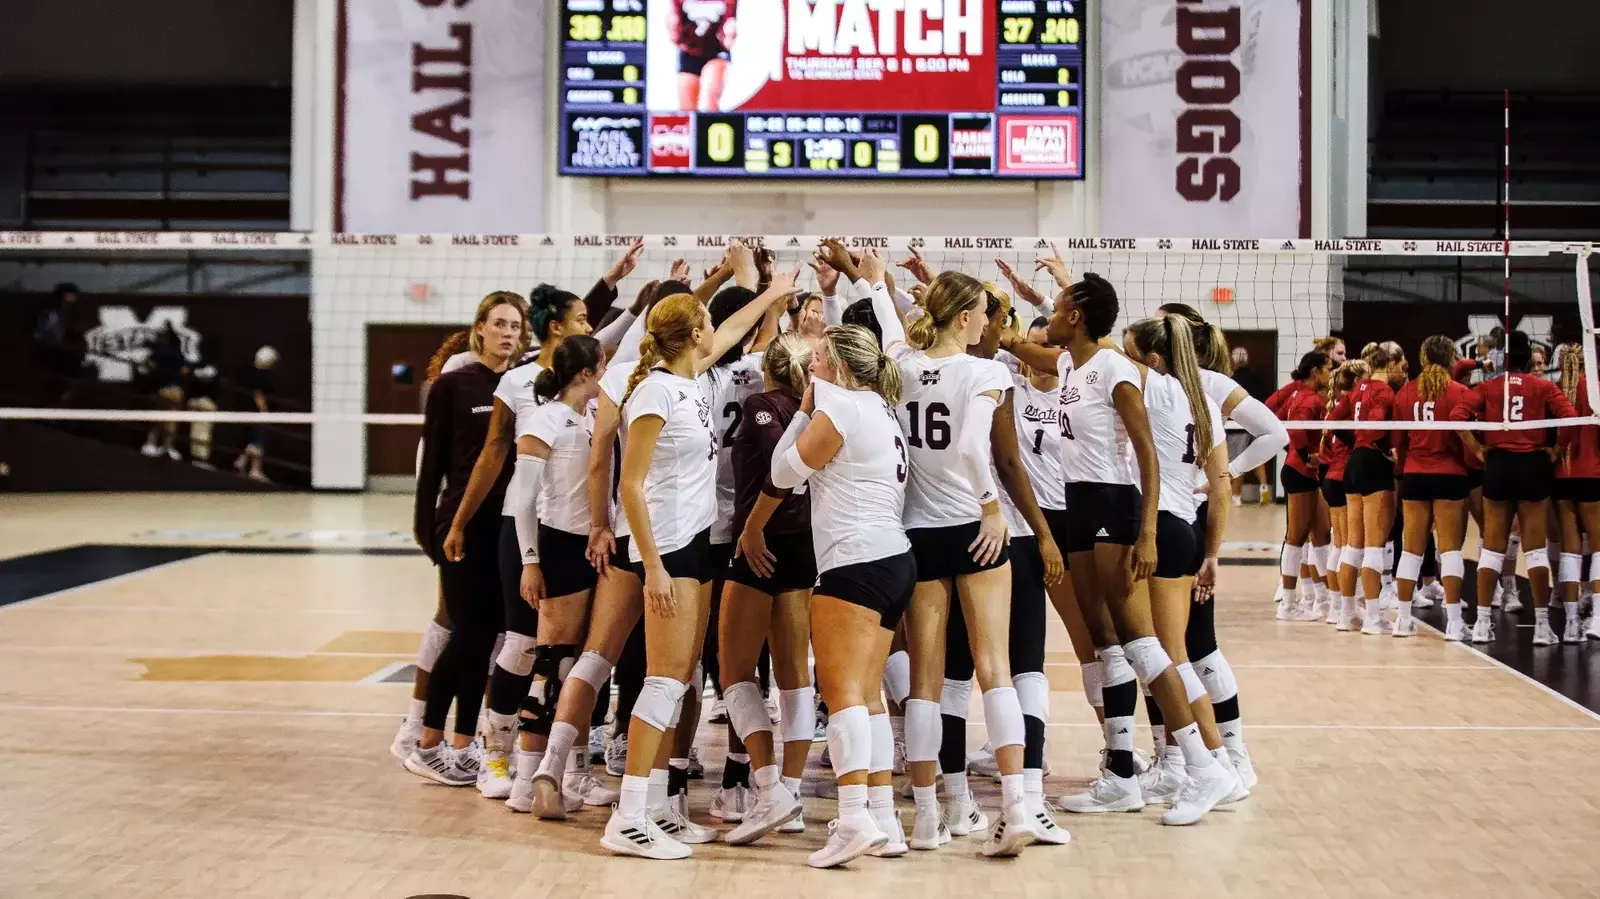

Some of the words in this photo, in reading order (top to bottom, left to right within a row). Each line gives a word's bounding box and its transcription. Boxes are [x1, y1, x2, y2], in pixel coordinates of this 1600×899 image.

[788, 0, 983, 55] MATCH
[1003, 17, 1034, 43] 37
[1041, 18, 1079, 43] .240
[410, 22, 472, 201] HAIL
[1176, 0, 1241, 202] DOGS
[708, 123, 734, 163] 0
[773, 141, 792, 167] 3
[854, 141, 872, 167] 0
[914, 124, 939, 163] 0
[331, 234, 359, 245] HAIL
[362, 234, 397, 246] STATE
[451, 235, 480, 246] HAIL
[482, 235, 518, 246] STATE
[574, 235, 603, 246] HAIL
[605, 235, 641, 246] STAT
[697, 235, 726, 247] HAIL
[852, 237, 889, 248] STATE
[945, 237, 974, 249] HAIL
[976, 238, 1013, 249] STATE
[1068, 238, 1098, 250] HAIL
[1100, 238, 1136, 250] STATE
[1191, 239, 1221, 251] HAIL
[1223, 240, 1260, 251] STATE
[1314, 240, 1344, 252] HAIL
[1345, 240, 1382, 252] STATE
[1436, 241, 1466, 252] HAIL
[1467, 241, 1503, 252] STATE
[905, 401, 951, 450] 16
[1033, 429, 1044, 455] 1
[894, 435, 907, 483] 3
